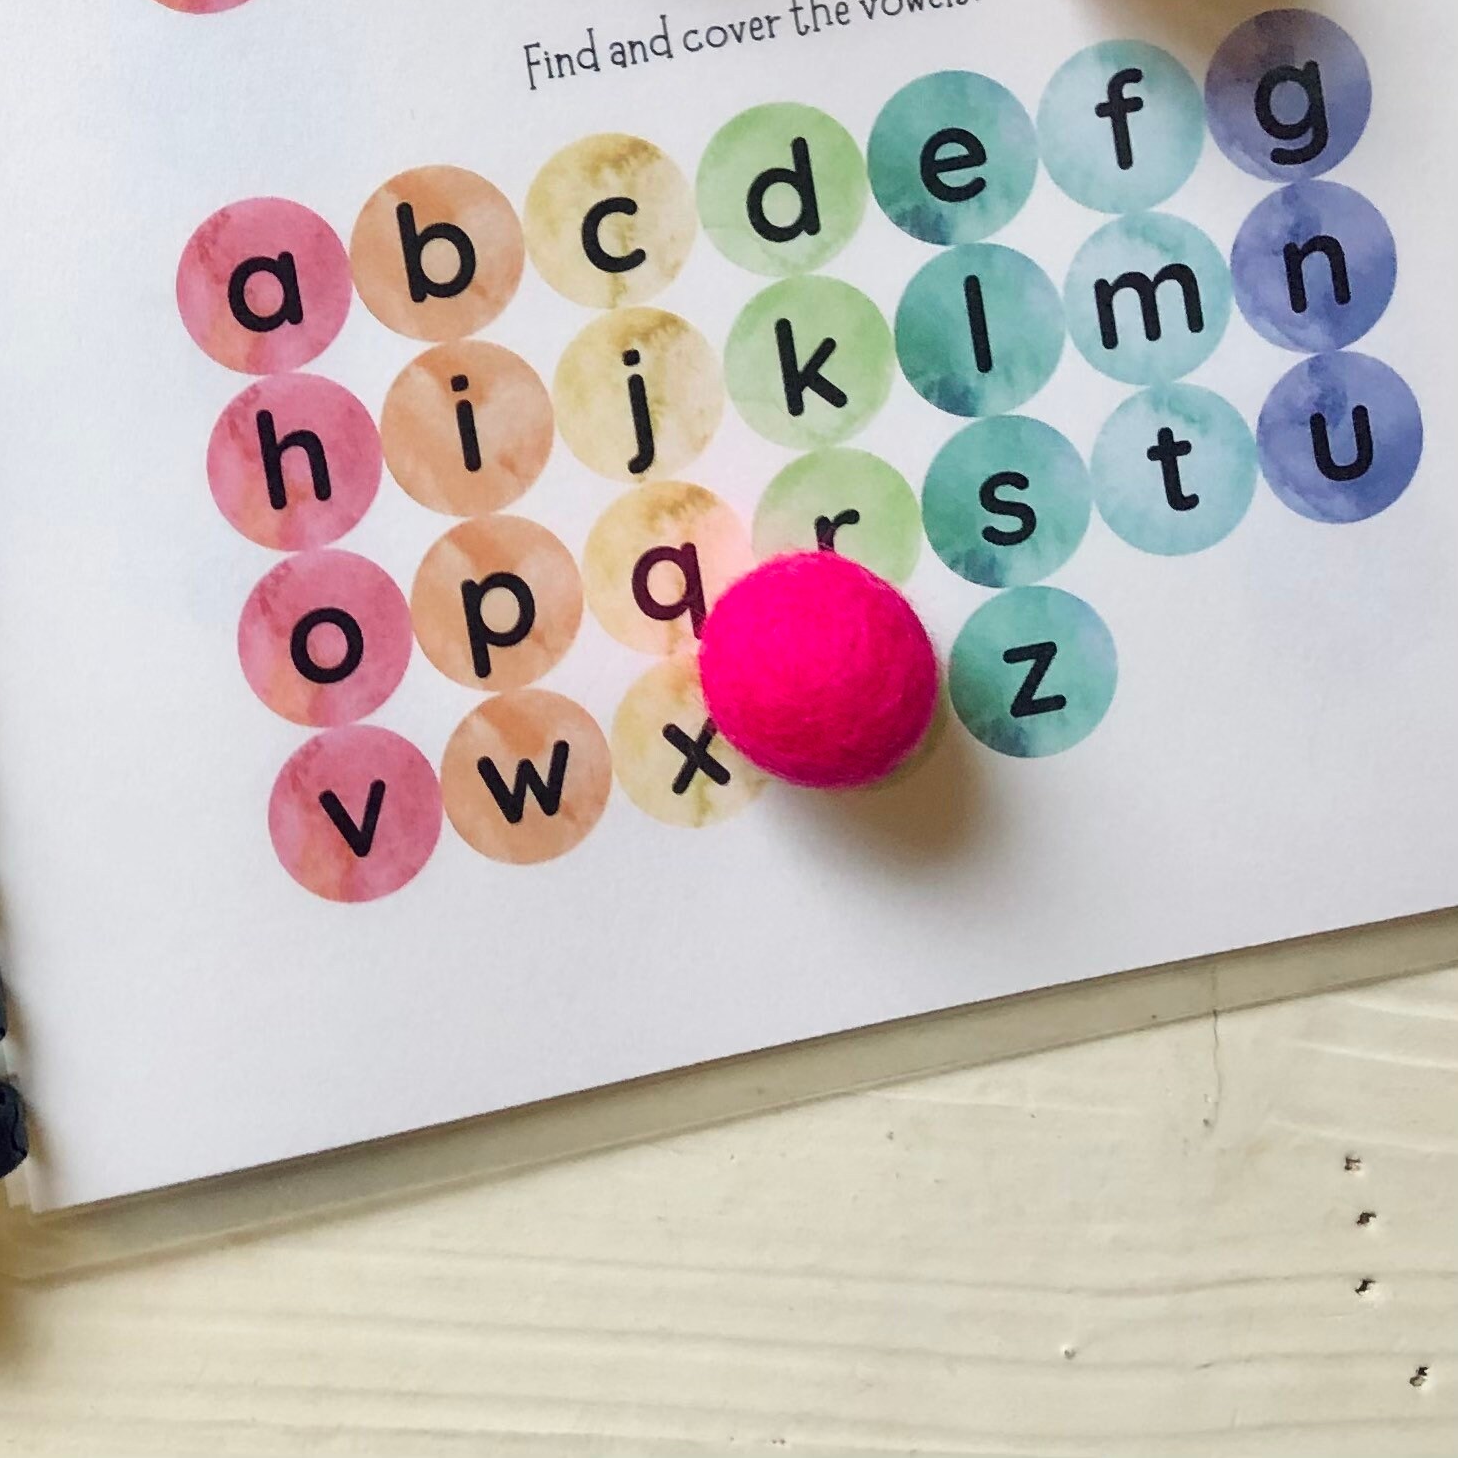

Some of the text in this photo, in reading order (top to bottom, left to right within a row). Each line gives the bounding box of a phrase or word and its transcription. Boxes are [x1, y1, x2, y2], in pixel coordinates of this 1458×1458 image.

[523, 27, 601, 91] Find
[609, 14, 674, 69] and
[682, 14, 782, 53] cover
[228, 56, 1330, 332] a b c d e f g
[257, 410, 331, 509] h
[451, 375, 481, 471] i
[623, 350, 654, 473] j
[775, 318, 847, 416] k
[1095, 264, 1203, 349] m
[1283, 236, 1351, 313] n
[291, 608, 363, 683] o
[462, 573, 535, 678] p
[979, 472, 1036, 546] s
[1147, 428, 1199, 511] t
[1310, 405, 1373, 481] u
[319, 641, 1067, 857] v w x z
